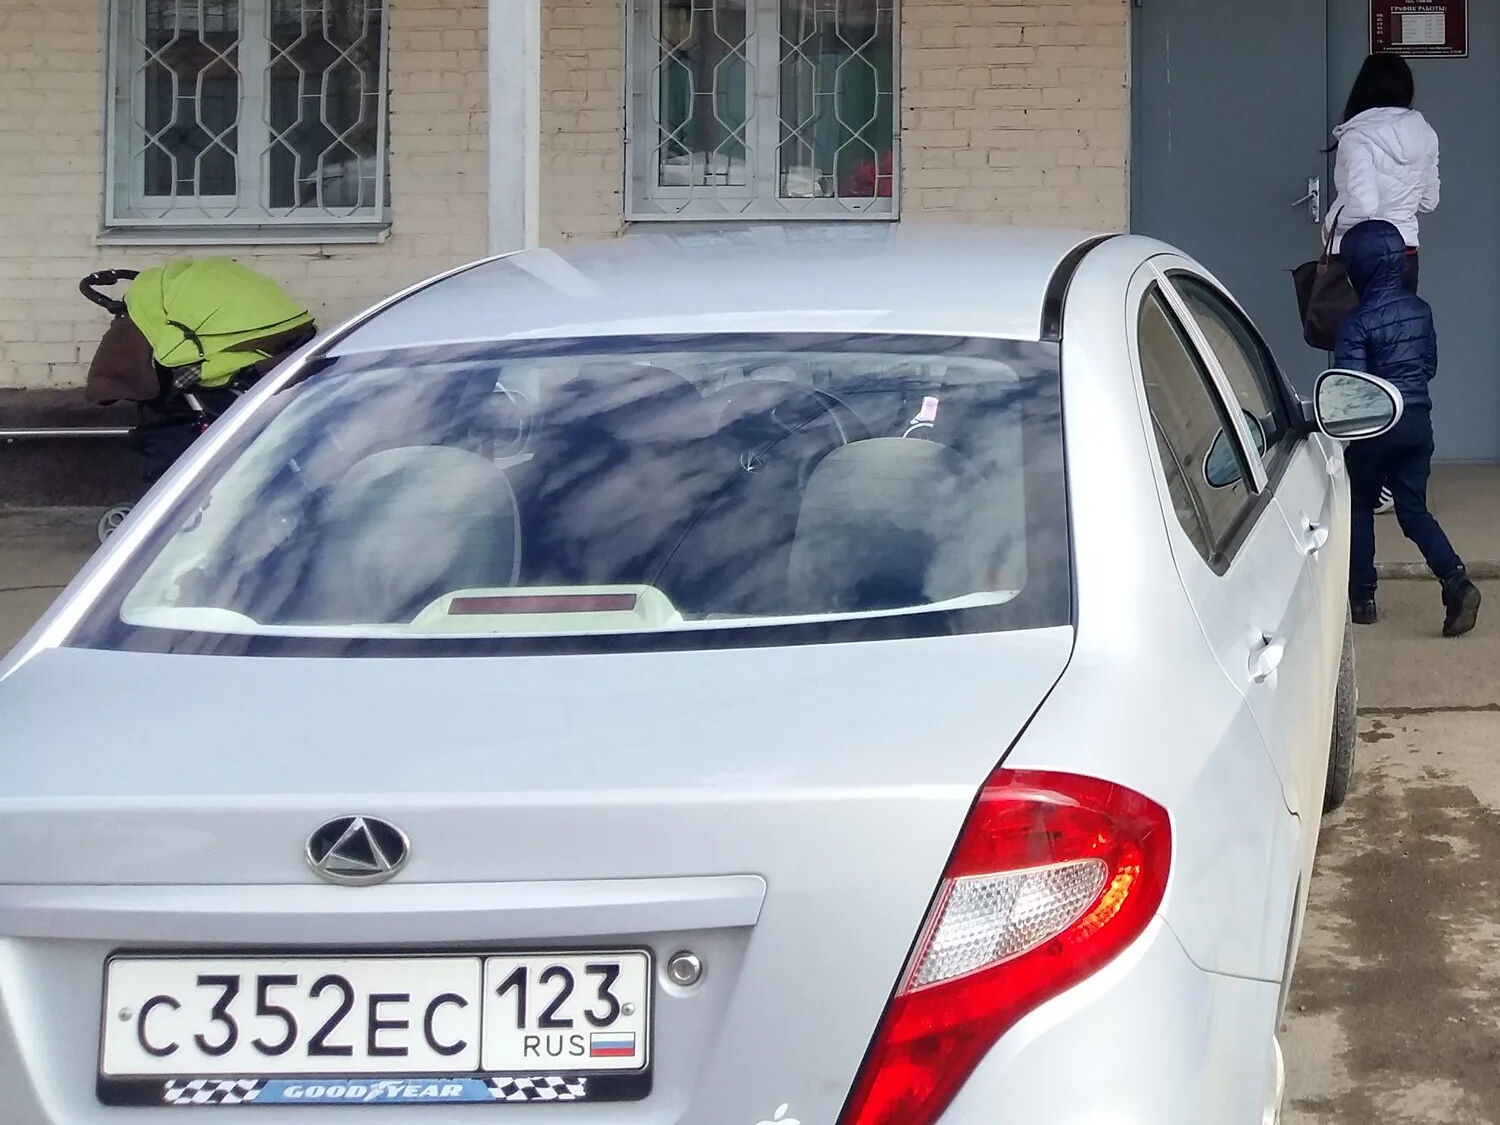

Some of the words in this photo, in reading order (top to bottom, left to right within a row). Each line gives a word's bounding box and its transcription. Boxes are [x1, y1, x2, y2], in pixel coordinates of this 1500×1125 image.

[136, 973, 469, 1058] С352ЕС
[494, 964, 622, 1030] 123
[523, 1035, 586, 1058] RUS
